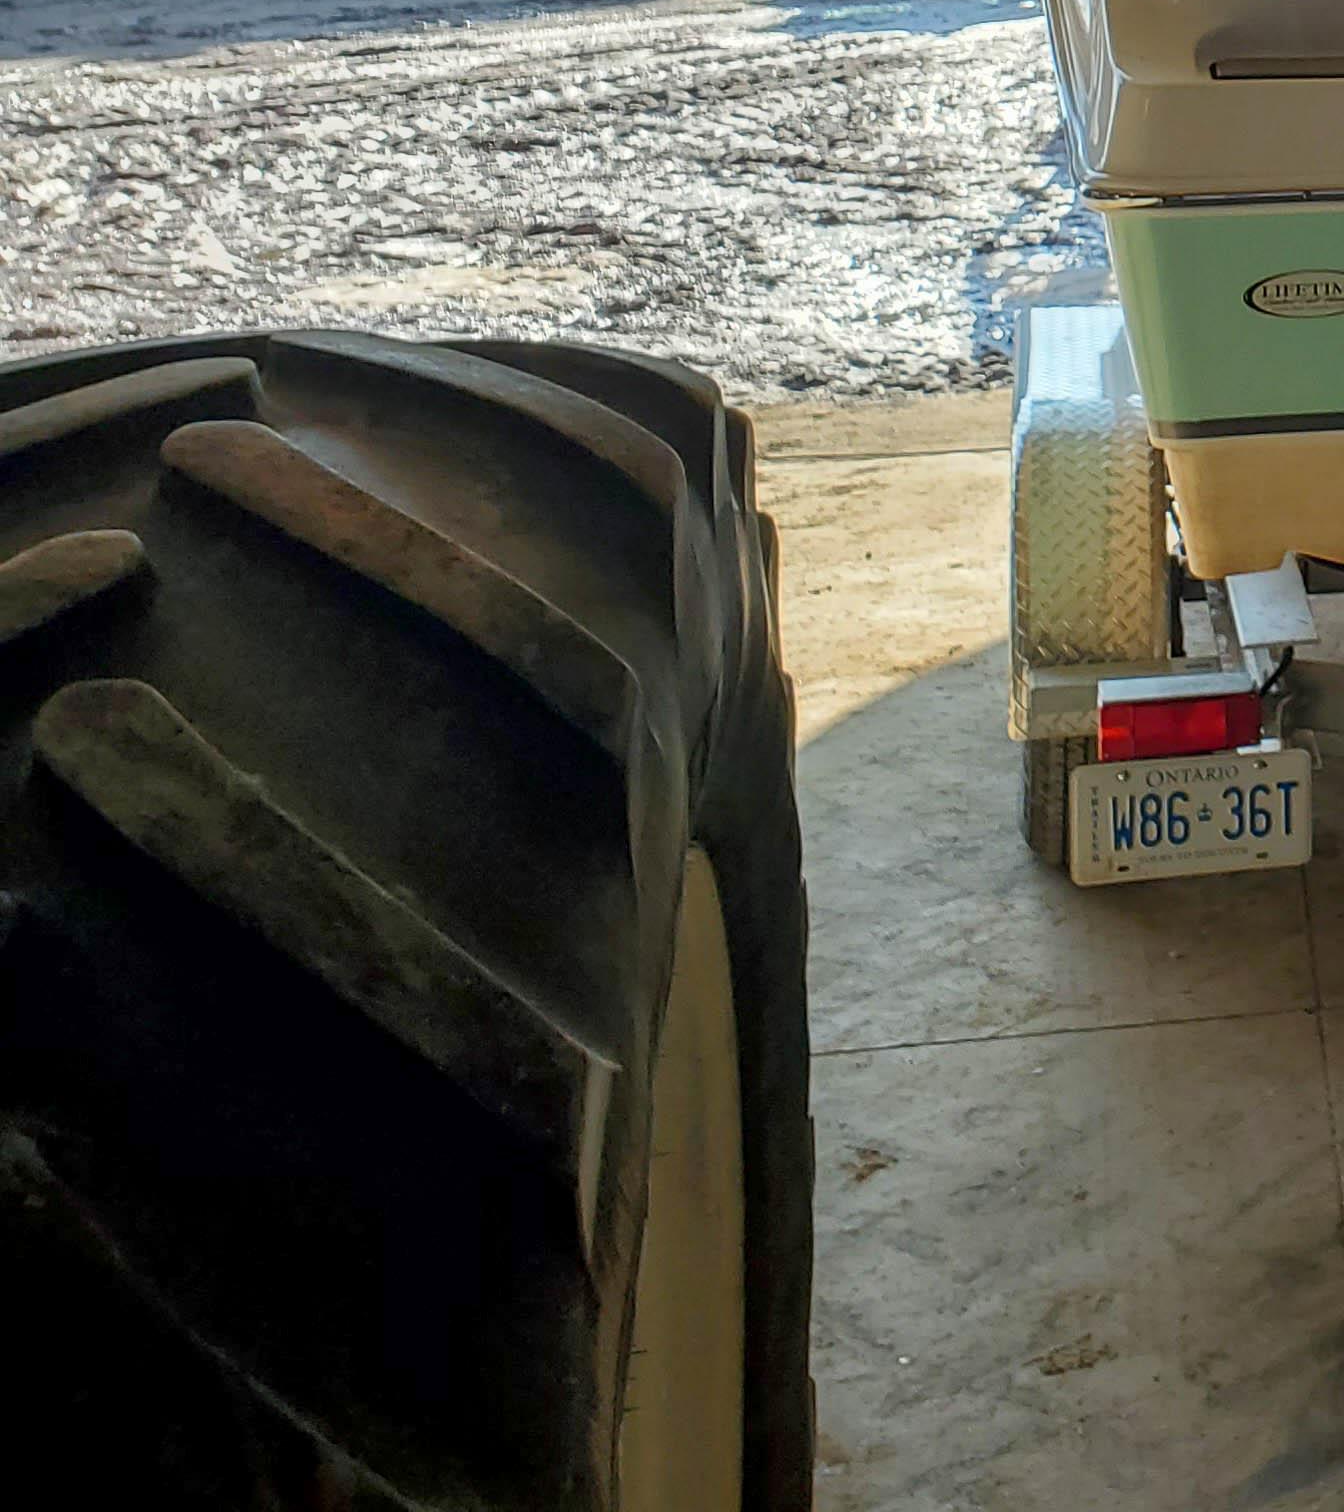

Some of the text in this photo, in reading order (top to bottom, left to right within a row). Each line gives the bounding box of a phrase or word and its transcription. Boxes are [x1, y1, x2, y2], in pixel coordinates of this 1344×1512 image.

[1145, 765, 1240, 788] ONTARIO
[1110, 781, 1300, 852] W86 36T
